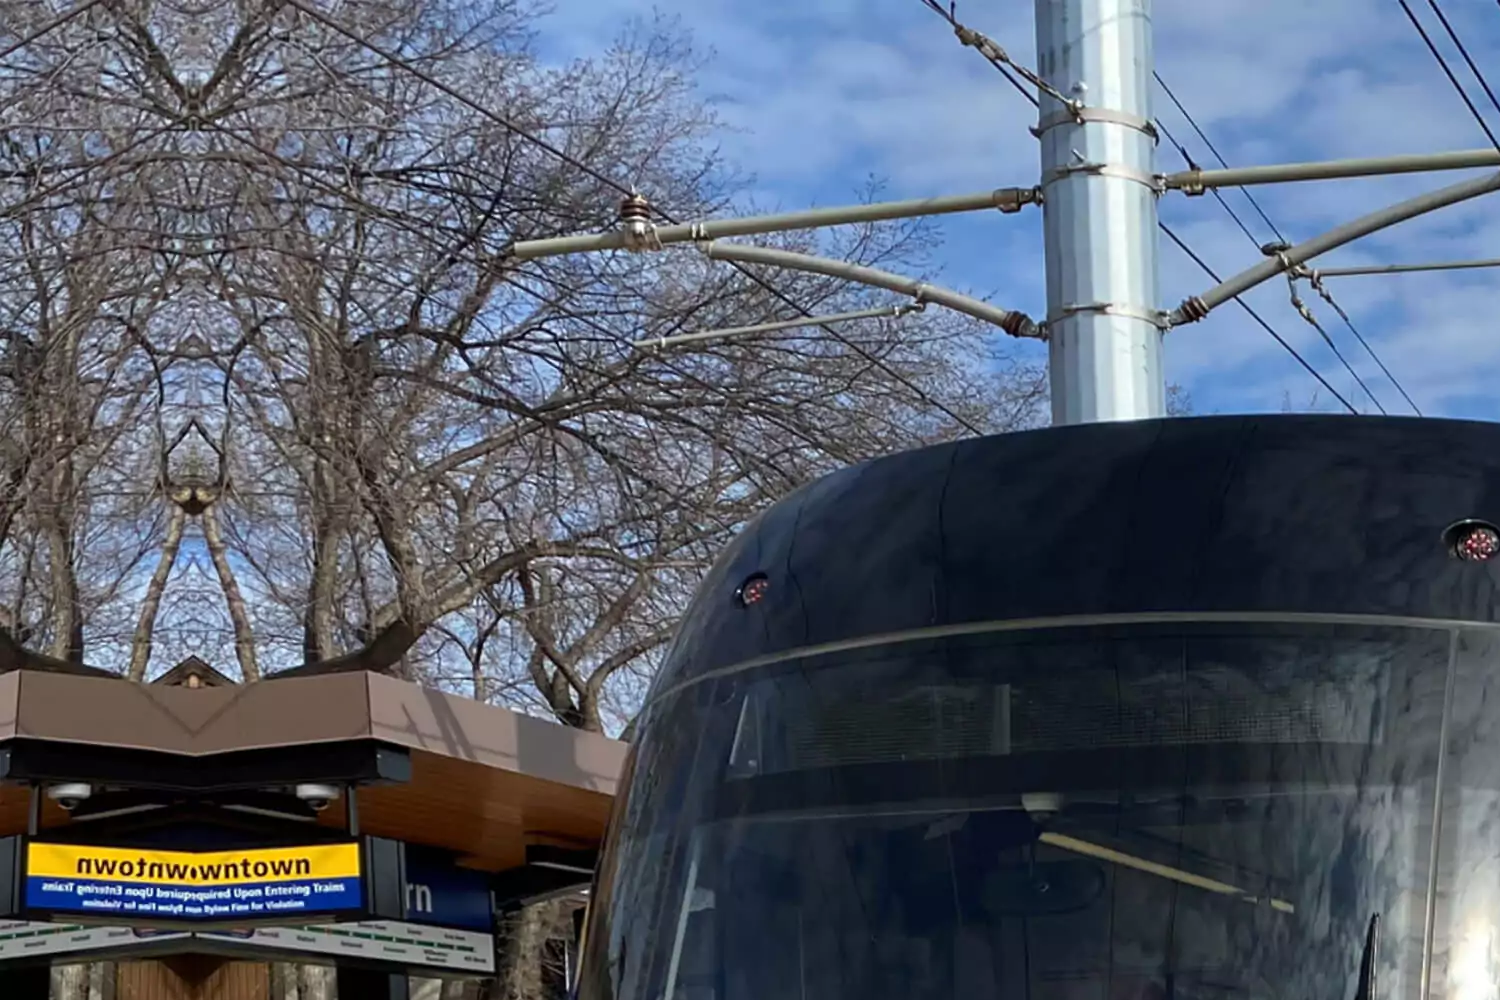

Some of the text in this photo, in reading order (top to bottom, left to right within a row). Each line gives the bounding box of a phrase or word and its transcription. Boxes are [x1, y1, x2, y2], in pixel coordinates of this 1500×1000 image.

[233, 886, 262, 900] Upon
[264, 883, 311, 897] Entering
[312, 882, 345, 893] Trains
